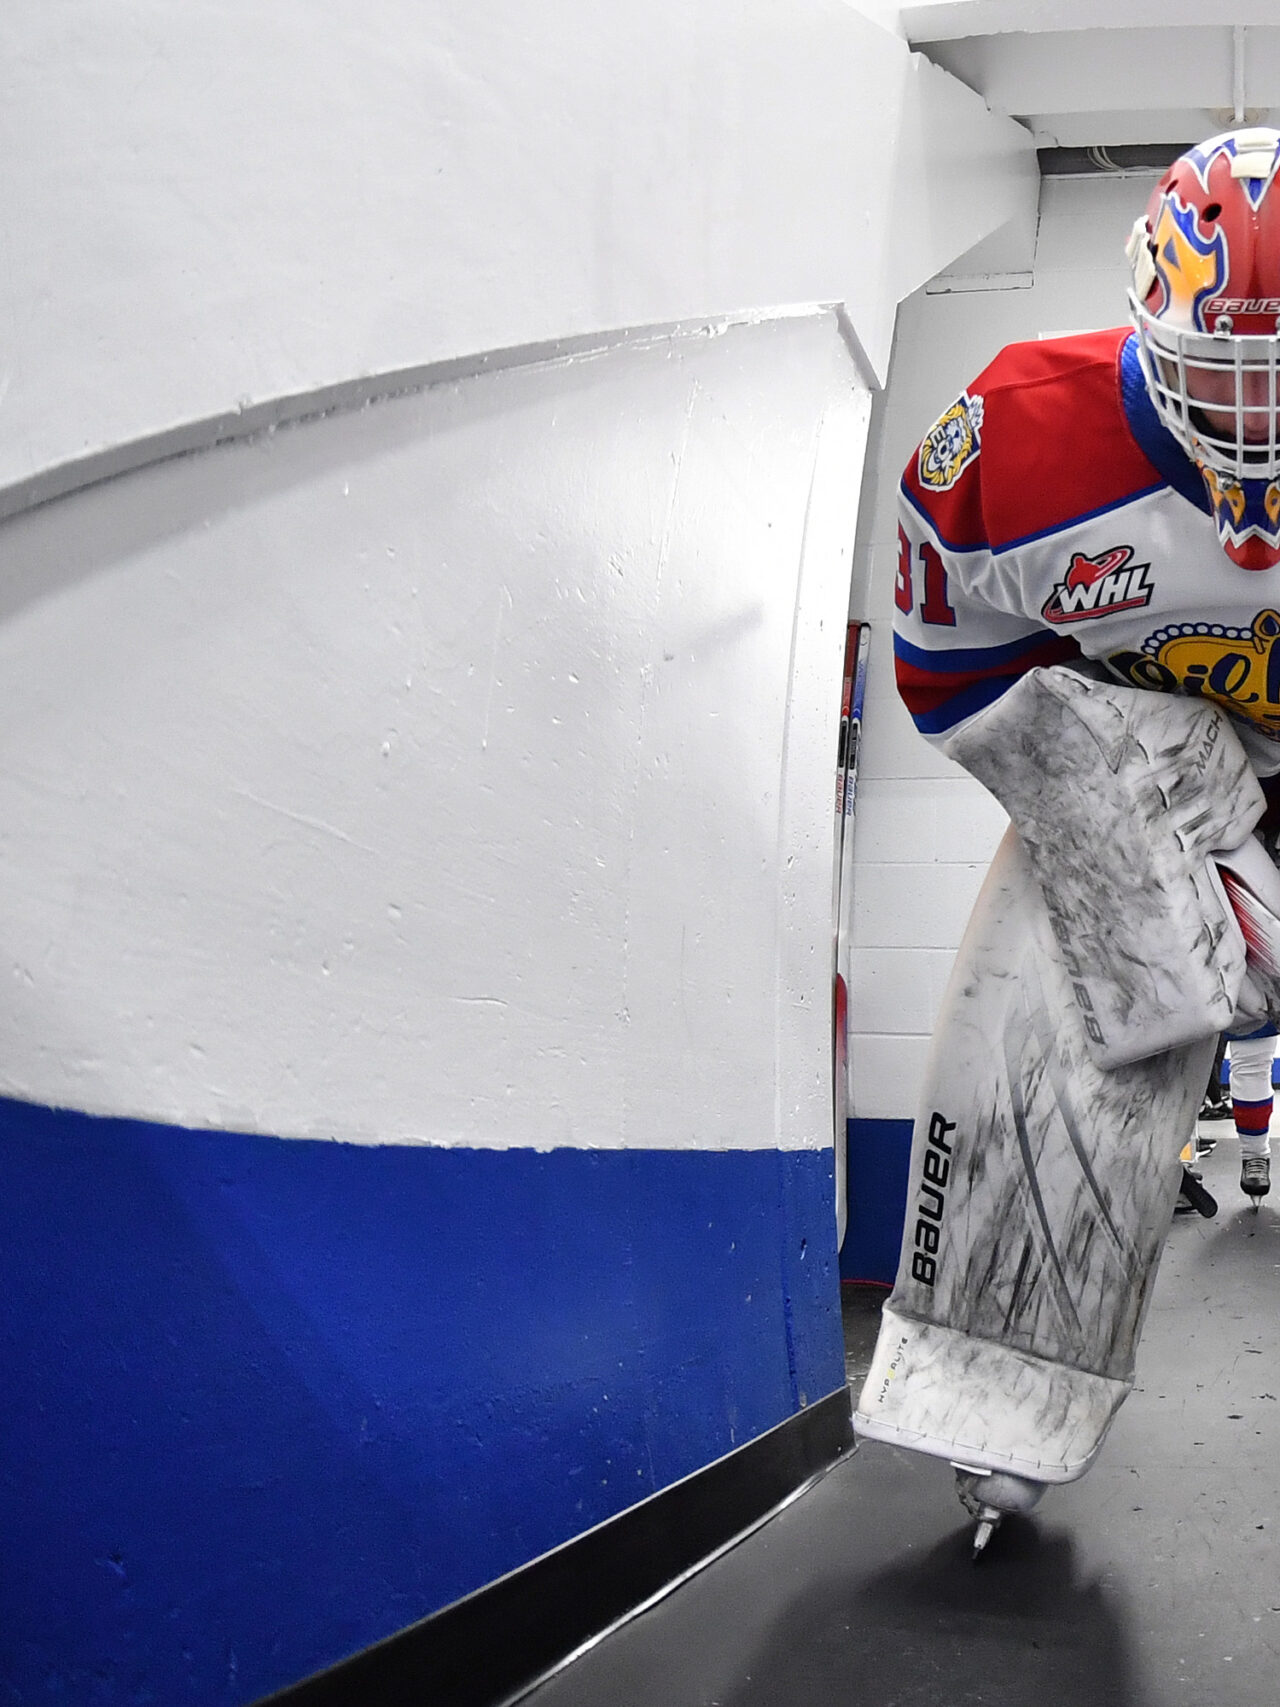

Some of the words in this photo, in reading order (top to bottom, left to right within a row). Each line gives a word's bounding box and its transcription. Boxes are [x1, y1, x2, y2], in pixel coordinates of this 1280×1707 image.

[1058, 564, 1152, 614] WHL
[1194, 710, 1223, 776] MACH
[912, 1111, 957, 1287] BAUER
